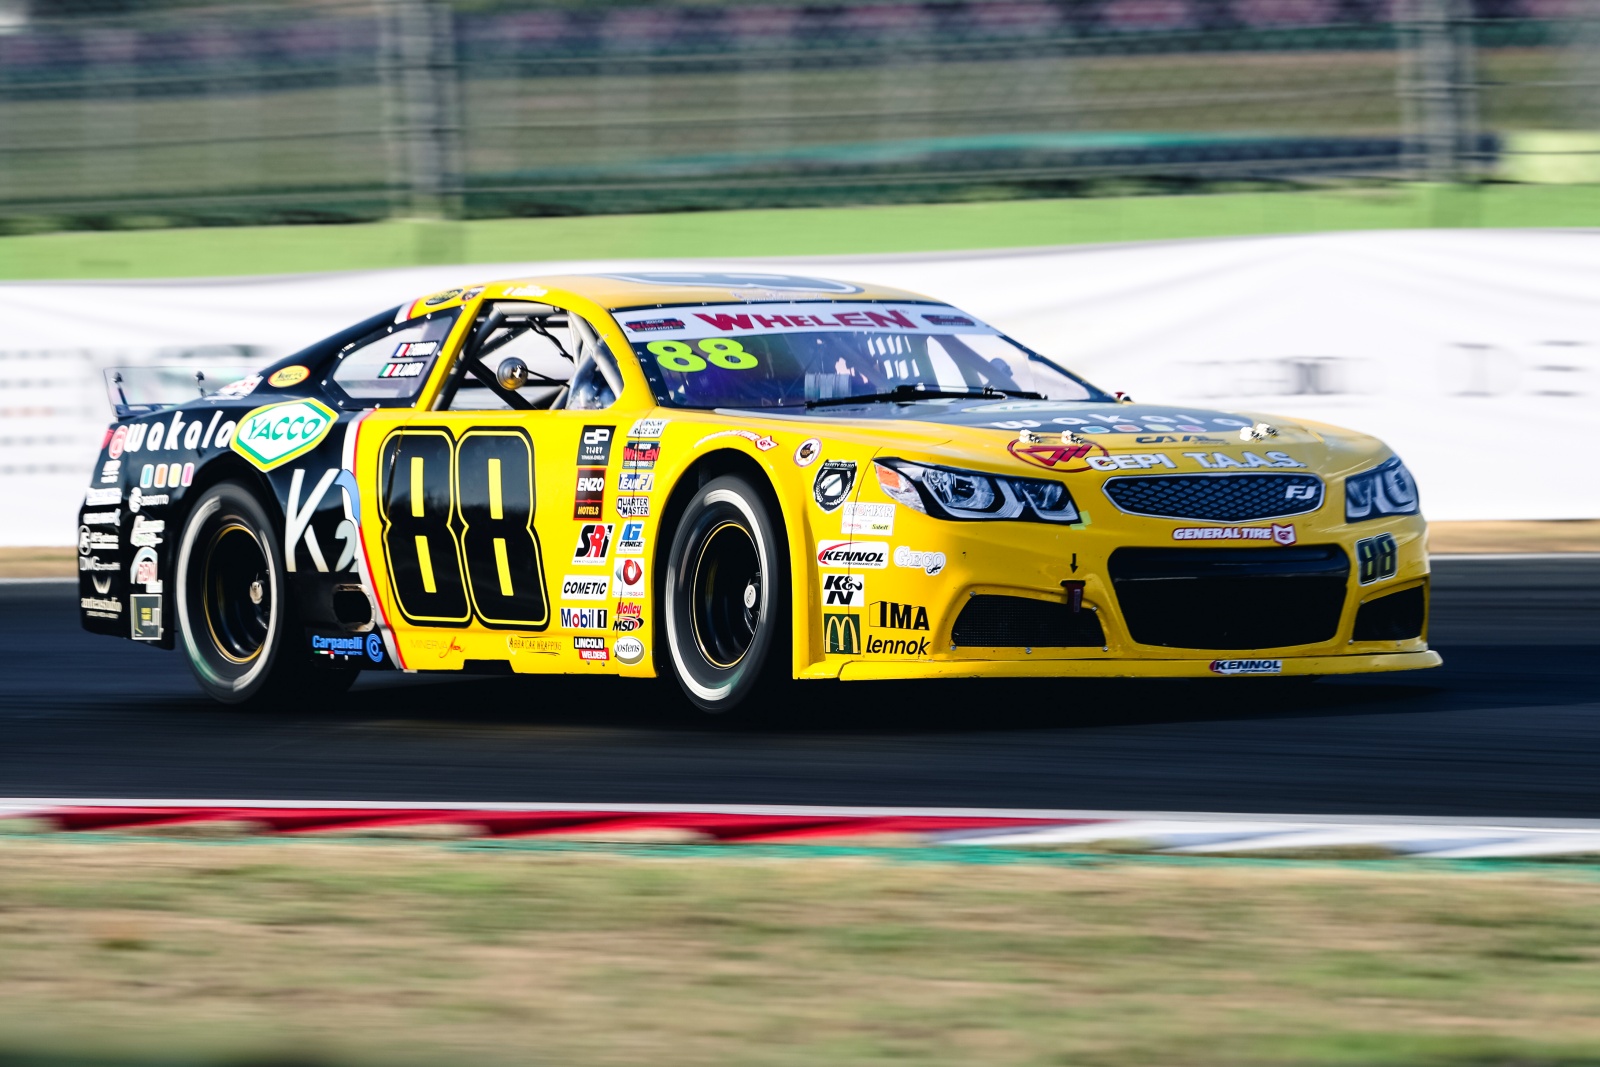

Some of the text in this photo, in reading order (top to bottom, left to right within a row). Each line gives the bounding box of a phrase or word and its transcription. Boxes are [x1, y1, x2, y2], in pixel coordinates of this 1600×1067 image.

[692, 310, 918, 332] WHELEN
[646, 338, 759, 373] 88
[990, 412, 1250, 429] wakala
[124, 410, 237, 453] wakala
[248, 416, 321, 441] YACCO
[623, 446, 660, 461] WHELEN
[1085, 453, 1177, 471] CEPI
[577, 478, 605, 492] ENZO
[1285, 485, 1316, 499] FJ
[577, 506, 599, 515] HOTELS
[617, 498, 648, 509] QUARTER
[622, 507, 648, 515] MASTER
[377, 425, 550, 631] 88
[622, 523, 643, 540] G
[1173, 526, 1272, 540] GENERAL TIRE
[822, 551, 885, 562] KENNOL
[1355, 532, 1398, 586] 88
[563, 581, 607, 594] COMETIC
[616, 601, 642, 618] Holley
[879, 601, 930, 631] IMA
[561, 608, 594, 628] Mobil
[612, 620, 635, 631] MSD
[312, 635, 363, 650] Carpanelli
[574, 638, 604, 649] LINCOLN
[581, 649, 608, 659] WELDERS
[1215, 660, 1282, 670] KENNOL
